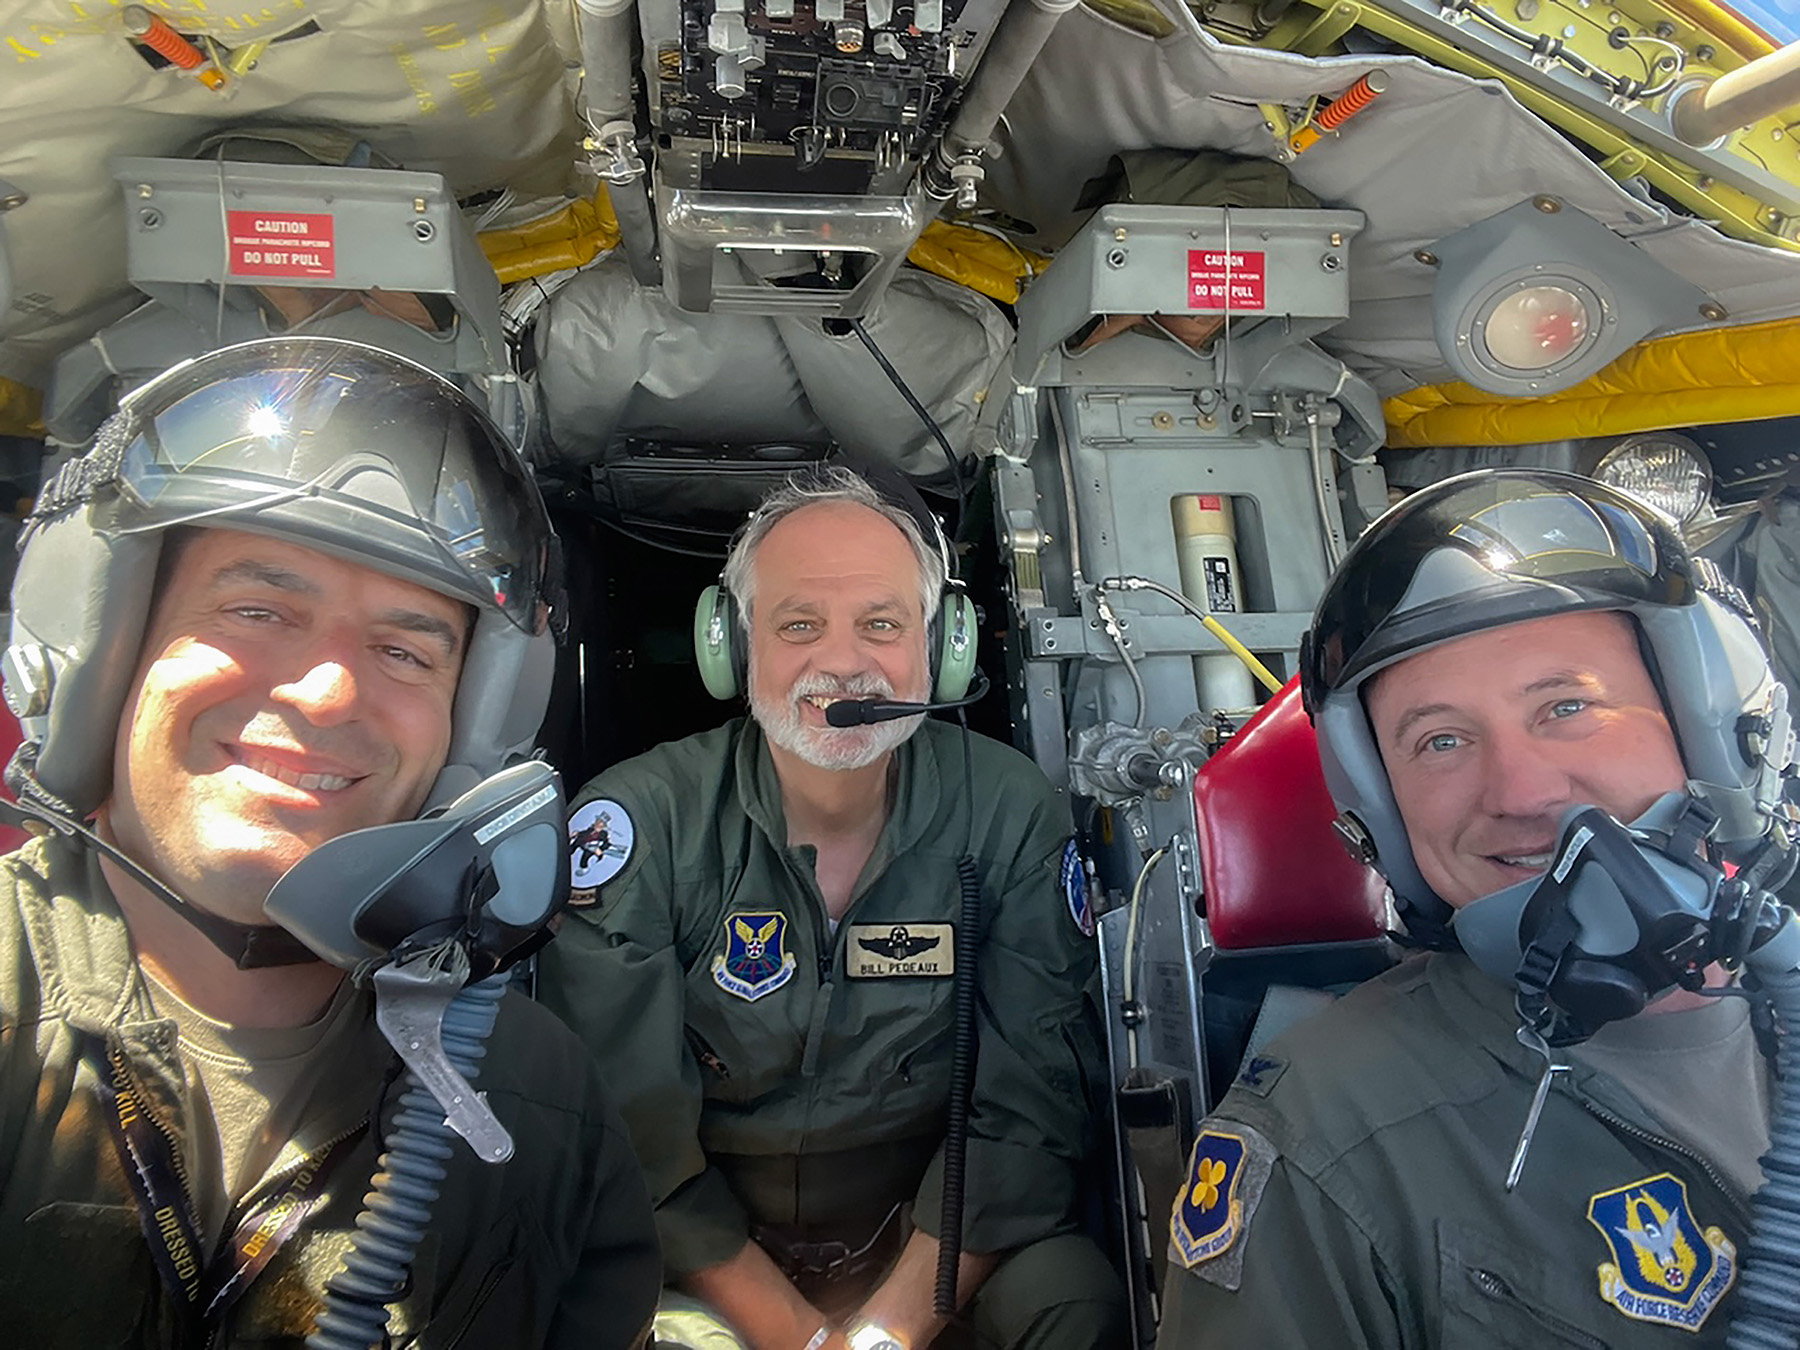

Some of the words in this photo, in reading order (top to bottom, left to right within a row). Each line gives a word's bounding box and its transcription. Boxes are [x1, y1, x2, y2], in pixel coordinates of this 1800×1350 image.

[255, 220, 308, 234] CAUTION
[244, 251, 261, 264] DO
[264, 252, 289, 265] NOT
[291, 254, 322, 266] PULL
[1204, 254, 1244, 267] CAUTON
[1195, 284, 1208, 296] DO
[1231, 286, 1254, 298] PULL
[860, 963, 884, 975] BILL
[115, 1091, 138, 1131] KILL
[242, 1191, 299, 1258] DRESSED
[291, 1170, 313, 1192] TO
[154, 1204, 198, 1281] DRESSED
[1615, 1289, 1635, 1313] AIR
[1635, 1298, 1669, 1319] FORCE
